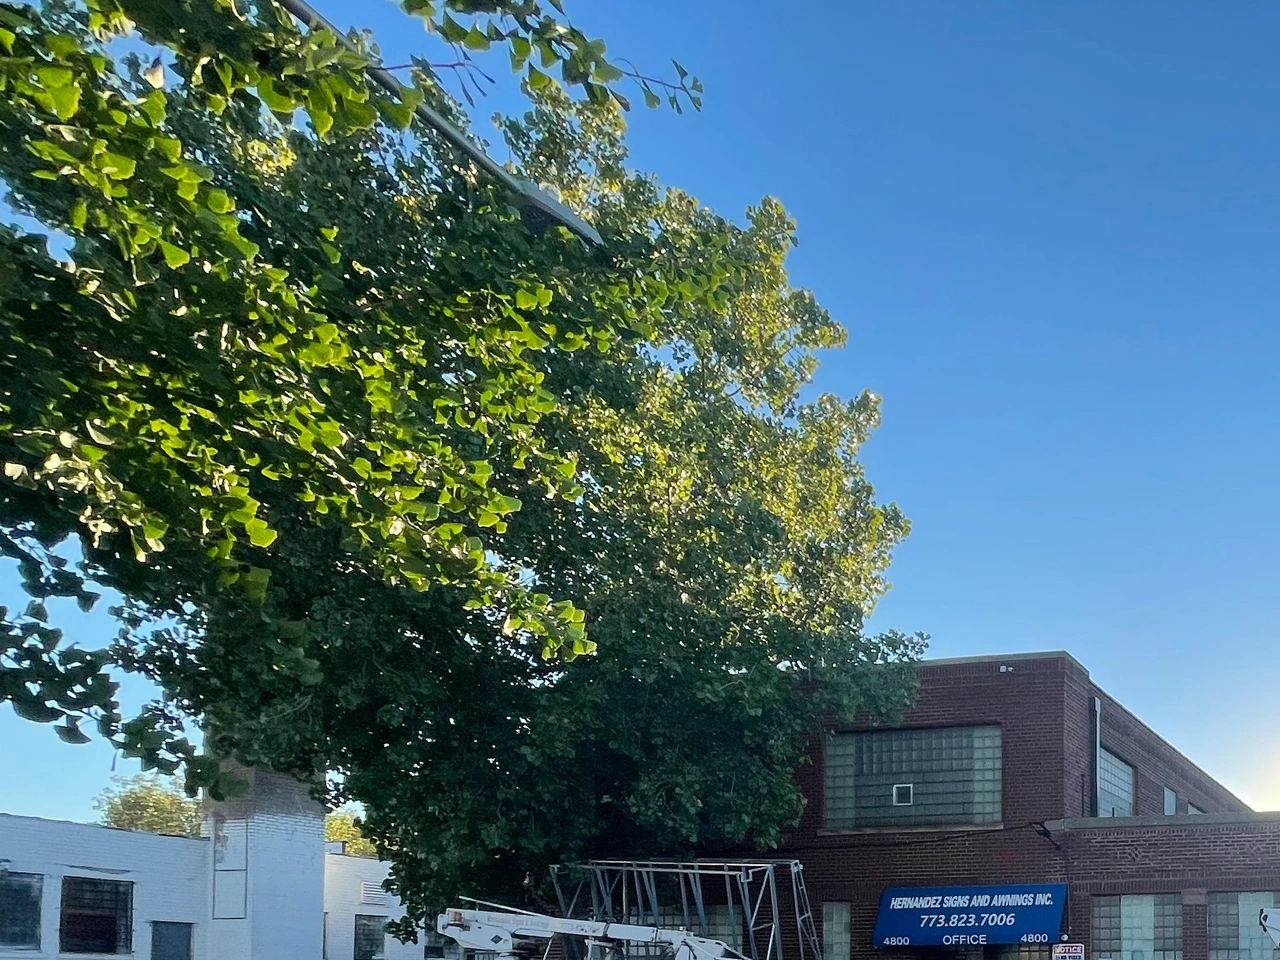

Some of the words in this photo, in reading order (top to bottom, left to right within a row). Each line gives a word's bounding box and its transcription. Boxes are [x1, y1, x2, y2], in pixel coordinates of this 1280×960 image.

[890, 896, 942, 909] HERNANDEZ
[943, 895, 970, 908] SIGNS
[970, 895, 990, 907] AND
[991, 894, 1034, 907] AWNINGS
[1034, 893, 1053, 905] INC.
[920, 913, 1016, 927] 773.823.7006
[883, 936, 910, 946] 4800
[942, 934, 988, 945] OFFICE
[1020, 933, 1049, 943] 4800
